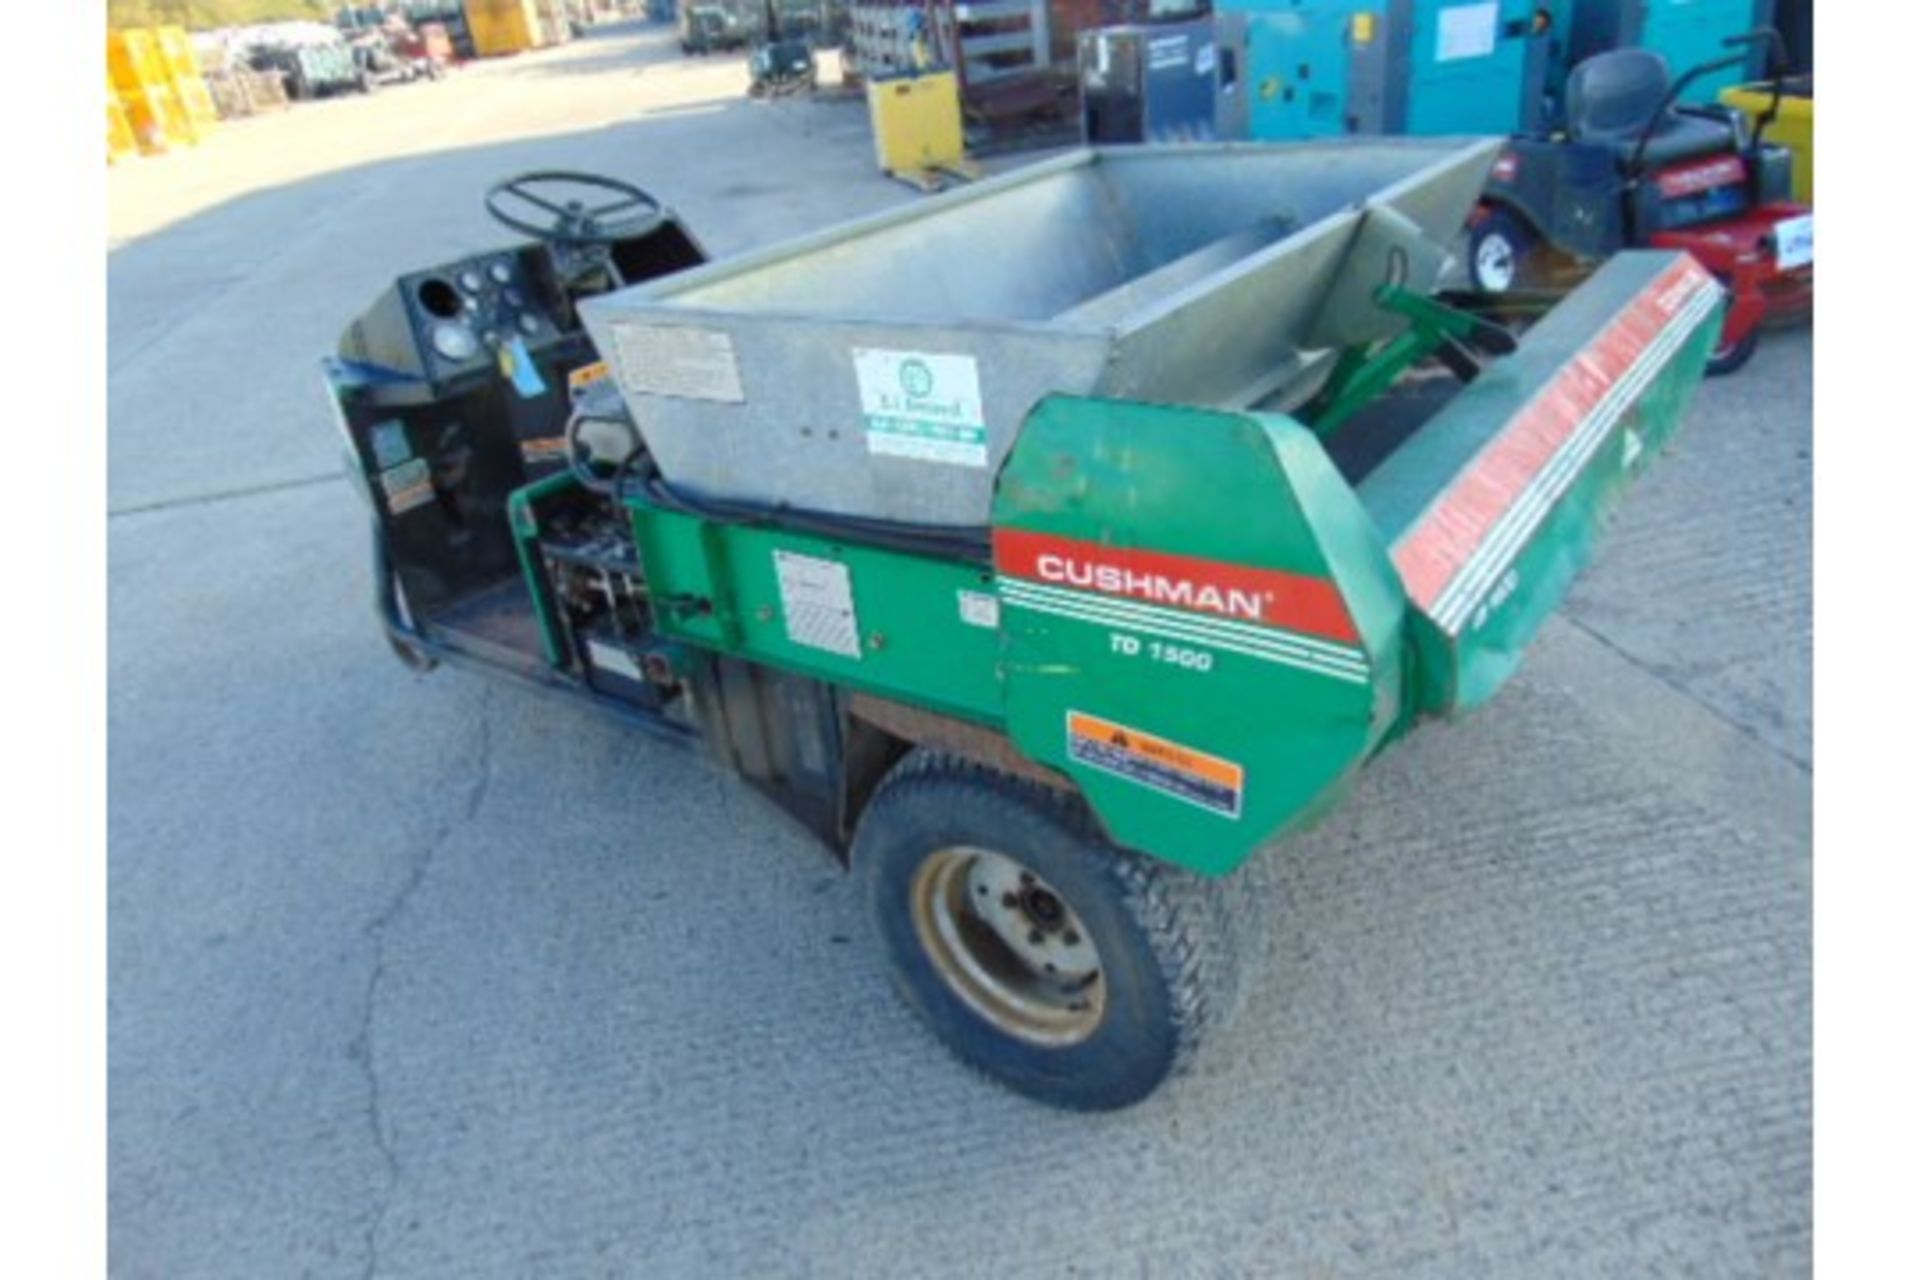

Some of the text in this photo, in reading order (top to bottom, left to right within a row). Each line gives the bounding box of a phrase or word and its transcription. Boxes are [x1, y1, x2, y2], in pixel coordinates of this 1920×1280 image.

[1036, 554, 1264, 618] CUSHMAN
[1109, 632, 1214, 672] TD 1500
